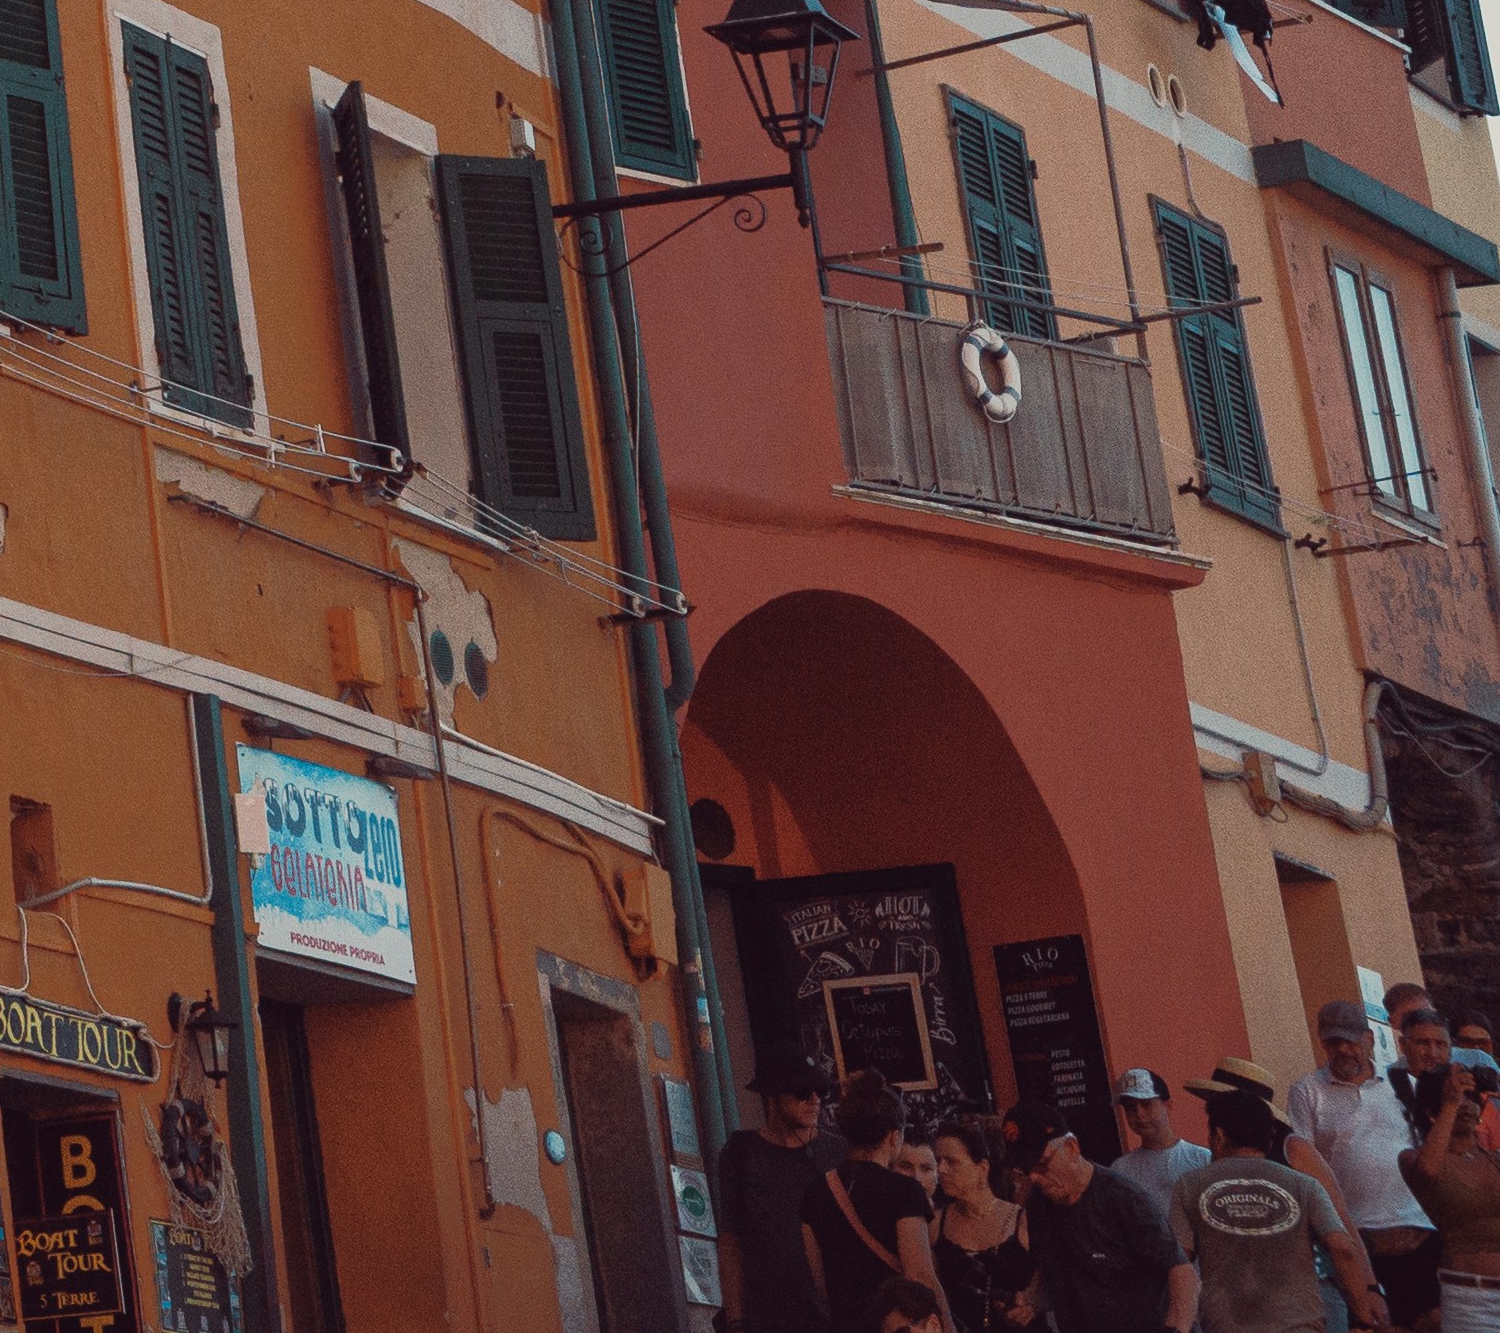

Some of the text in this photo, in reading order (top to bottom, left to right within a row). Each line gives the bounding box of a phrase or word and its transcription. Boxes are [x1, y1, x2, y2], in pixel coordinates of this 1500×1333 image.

[263, 778, 366, 855] SOTTO
[791, 903, 832, 925] ITALIAN
[885, 895, 923, 914] HOT
[790, 916, 849, 946] PIZZA
[290, 931, 386, 966] PRODUZIONE PROPRIA
[1022, 947, 1059, 967] RIO
[69, 1019, 145, 1075] TOUR
[1215, 1194, 1281, 1210] ORIGINALS
[17, 1229, 79, 1257] BOAT
[48, 1252, 113, 1280] TOUR
[40, 1292, 100, 1310] 5 TERRE
